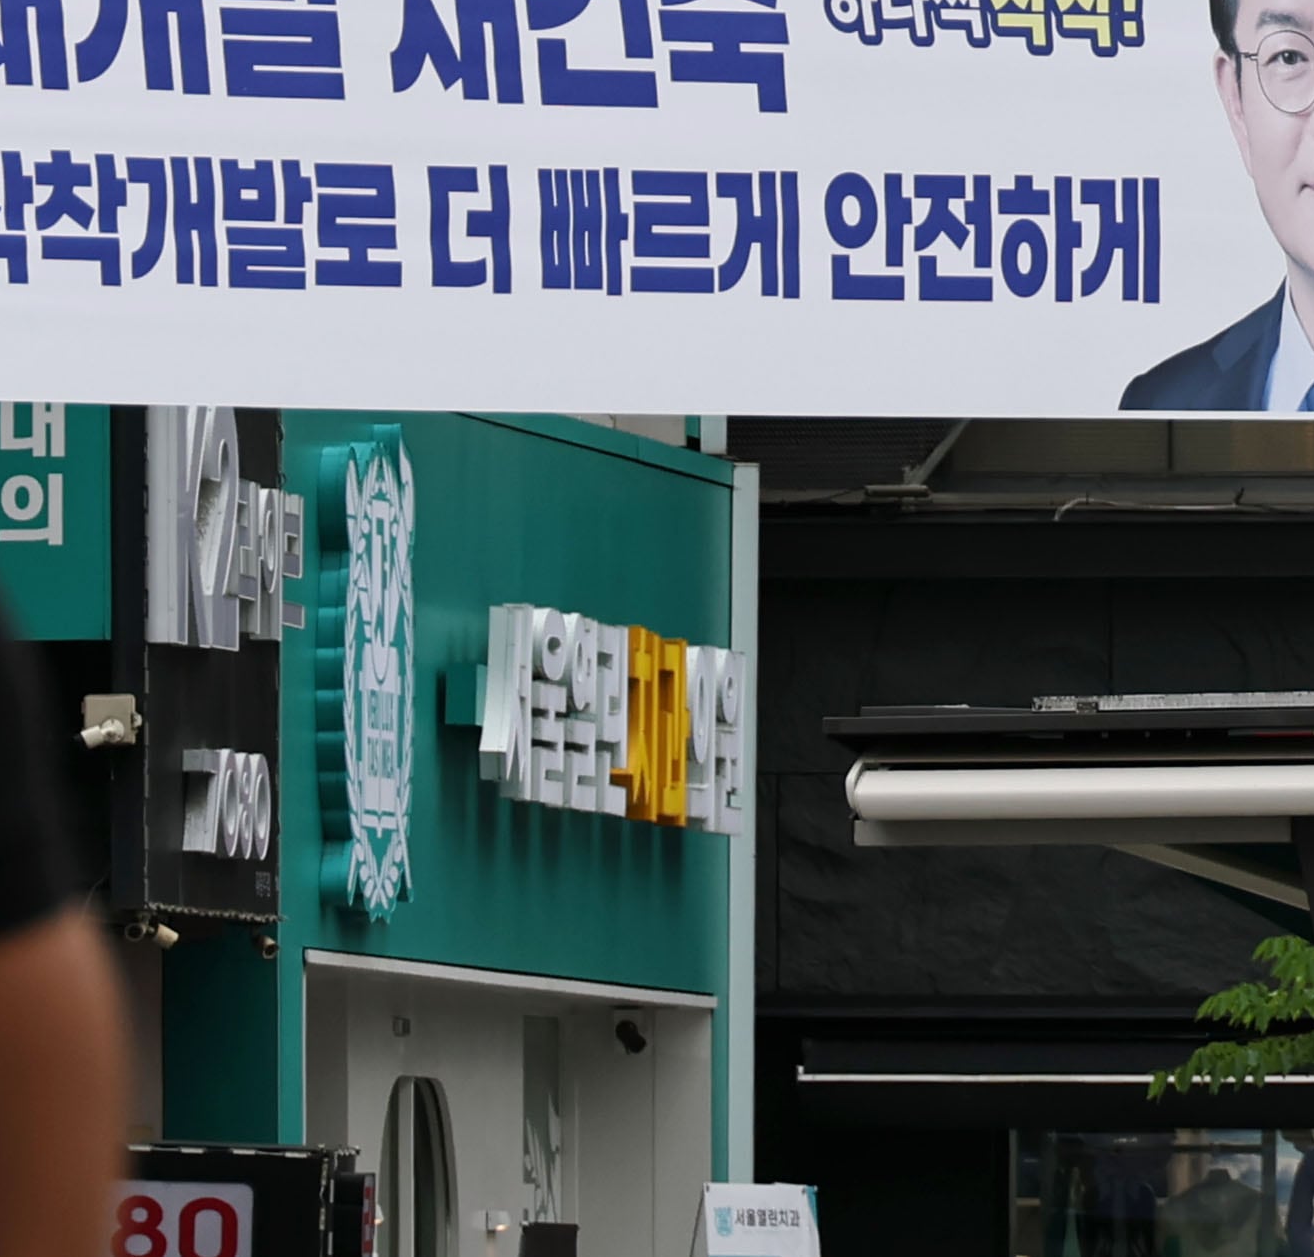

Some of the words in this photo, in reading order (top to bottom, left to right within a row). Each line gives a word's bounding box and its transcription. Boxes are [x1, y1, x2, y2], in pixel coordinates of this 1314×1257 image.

[427, 165, 513, 294] 더
[538, 167, 801, 300] 빠르게
[824, 173, 1161, 304] 안전하게
[734, 1207, 801, 1228] 서울열린치과
